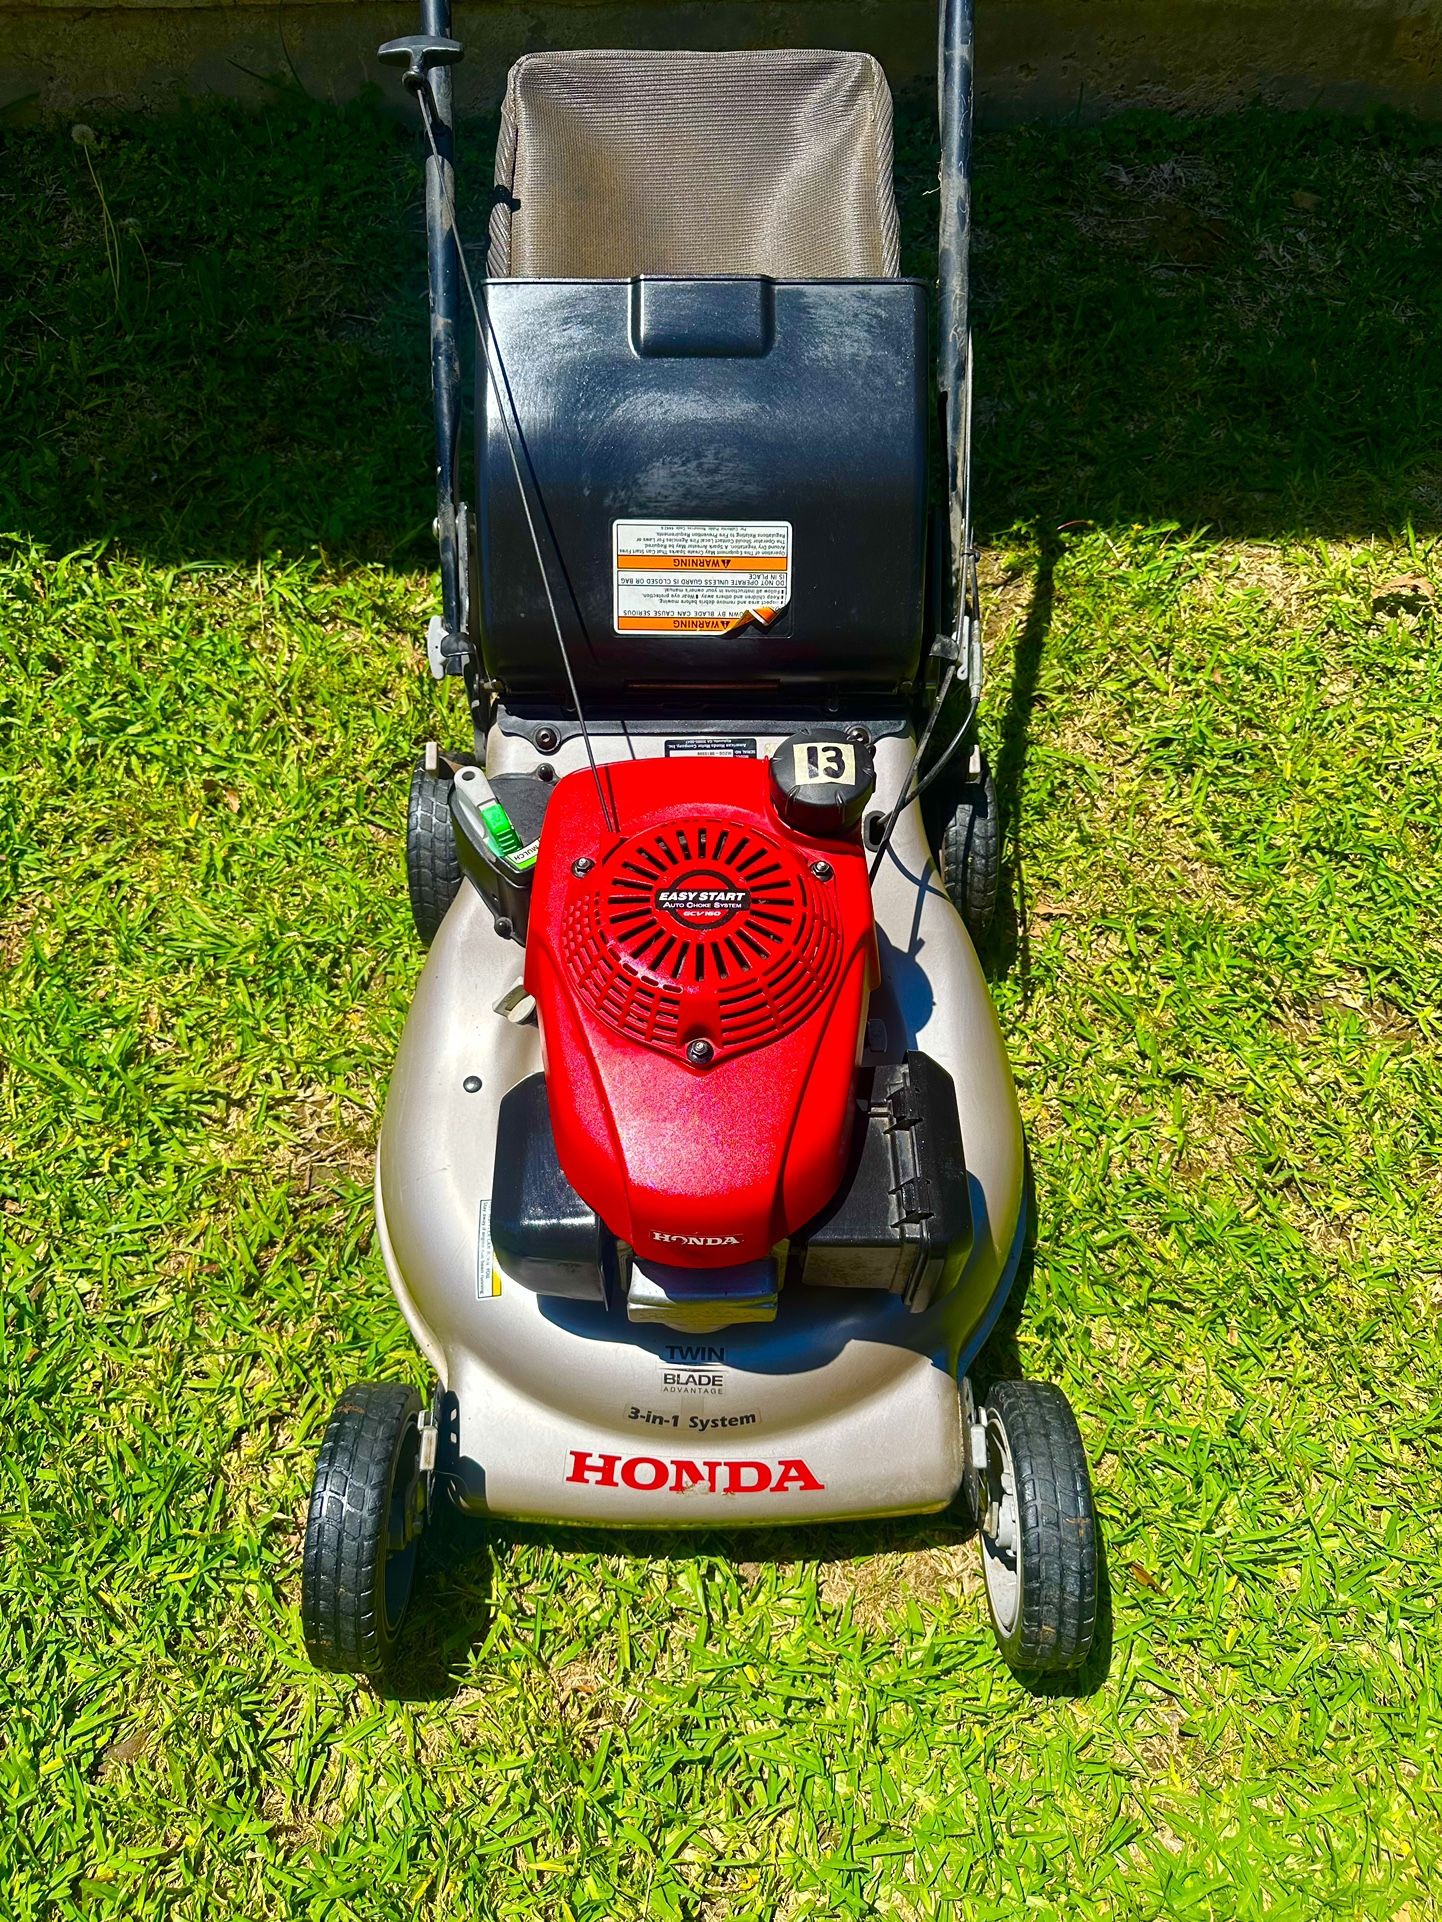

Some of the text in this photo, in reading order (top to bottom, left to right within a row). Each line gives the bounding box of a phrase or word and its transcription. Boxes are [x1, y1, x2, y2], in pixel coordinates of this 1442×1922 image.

[673, 559, 720, 567] WARNING
[673, 620, 719, 628] WARNING
[807, 746, 846, 779] 13
[514, 845, 538, 861] MULCH
[658, 892, 746, 901] EASY START
[653, 1231, 740, 1246] HONDA
[665, 1345, 725, 1362] TWIN
[664, 1373, 724, 1387] BLADE
[664, 1387, 724, 1395] ADVANTAGE
[628, 1406, 756, 1432] 3-in-1 System
[566, 1450, 825, 1493] HONDA
